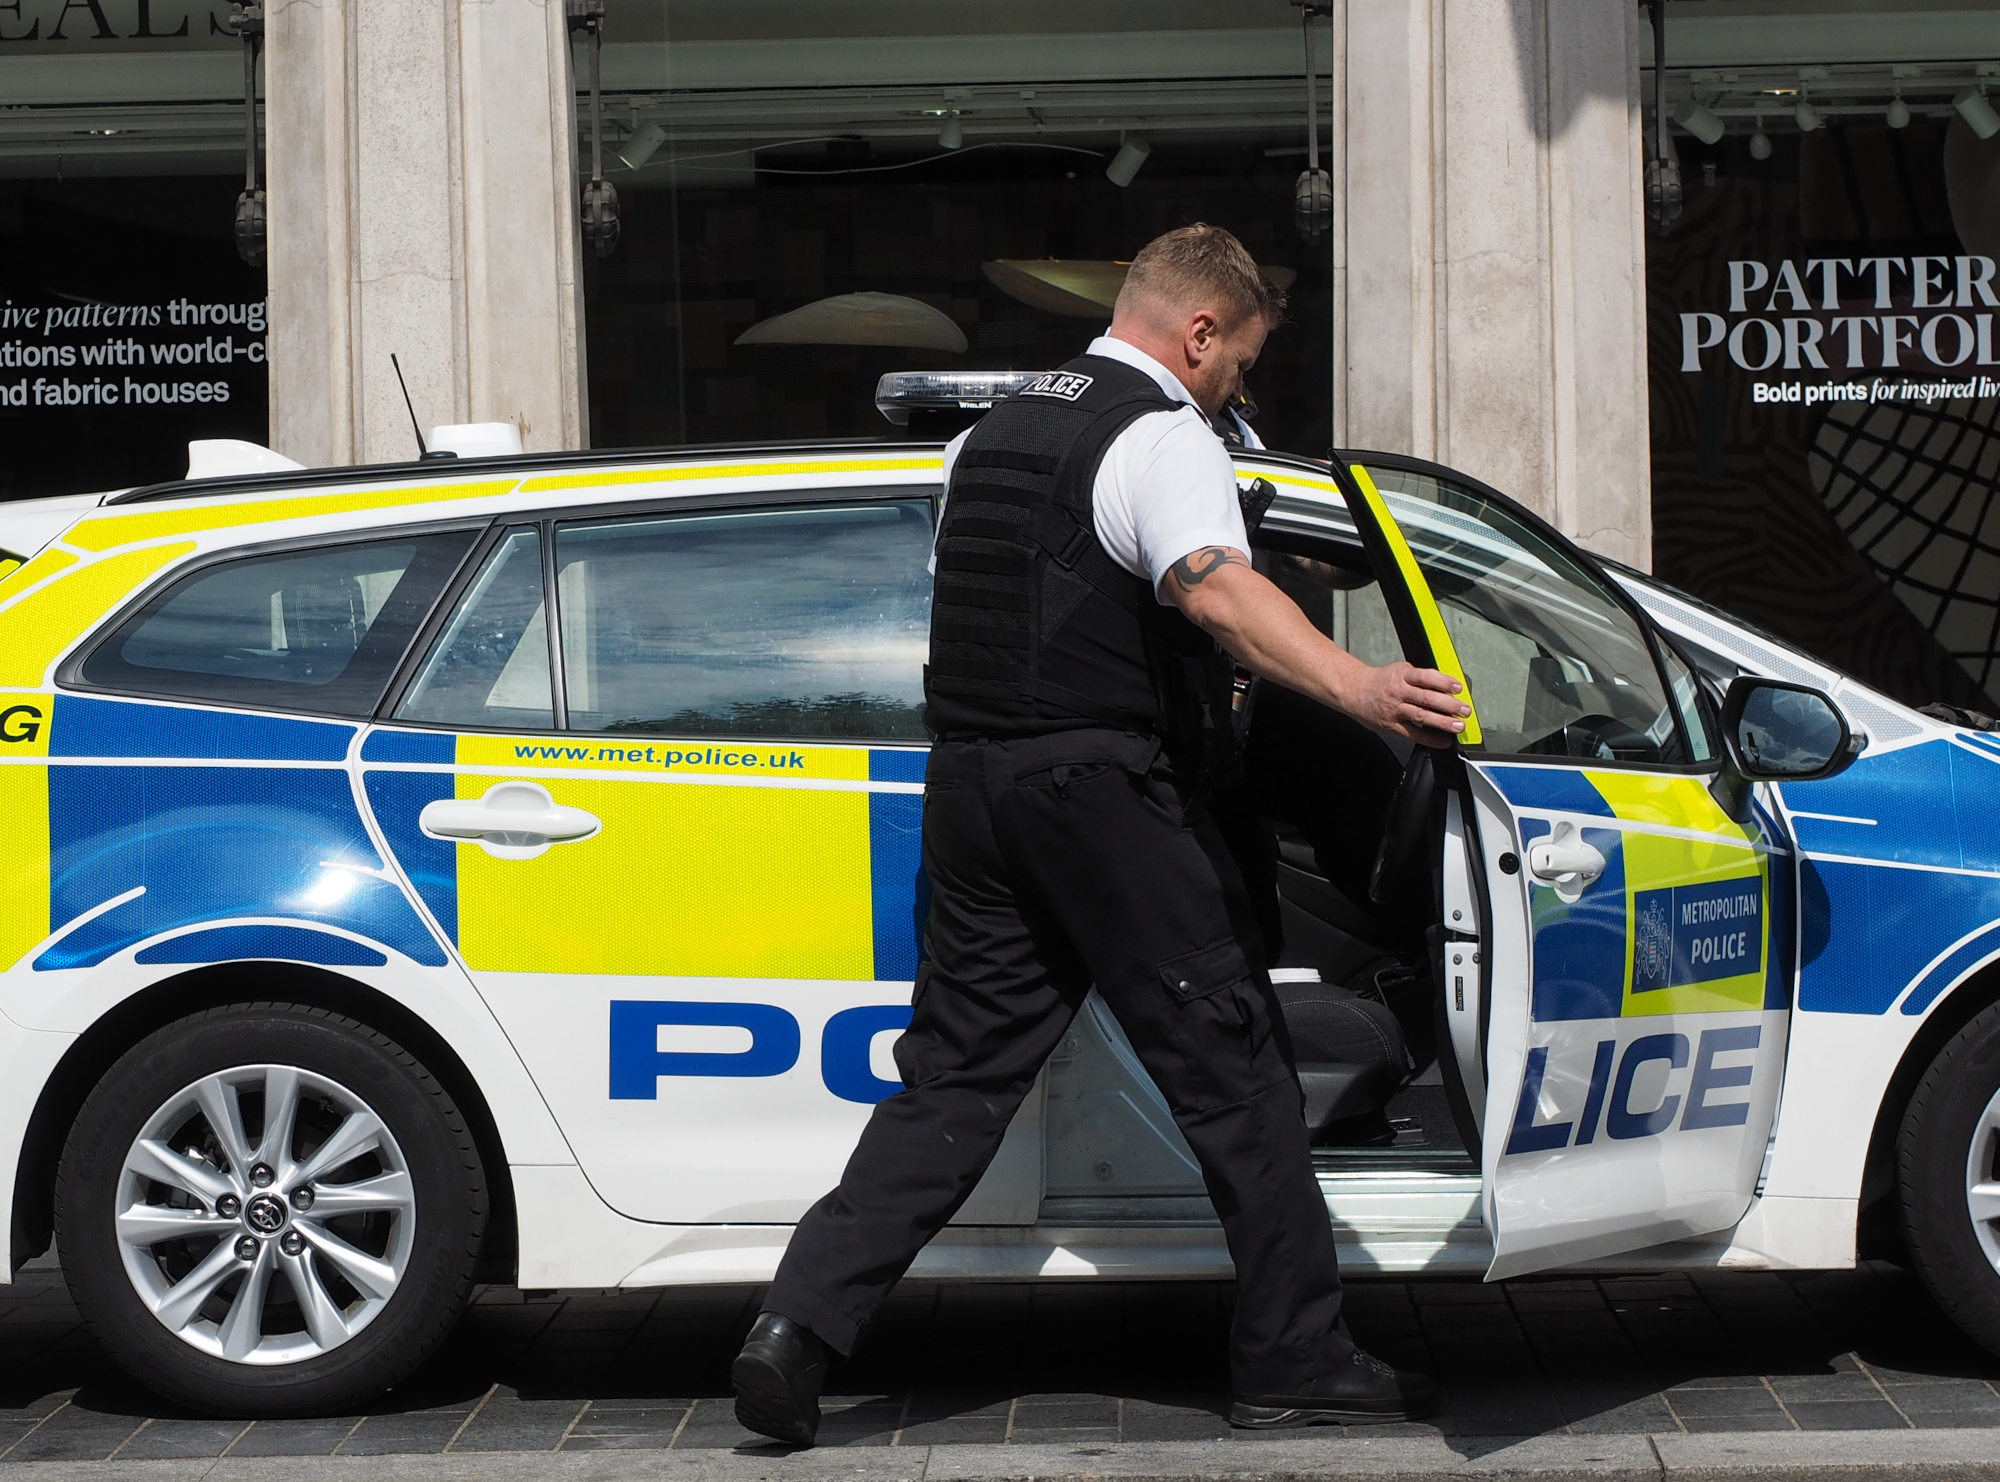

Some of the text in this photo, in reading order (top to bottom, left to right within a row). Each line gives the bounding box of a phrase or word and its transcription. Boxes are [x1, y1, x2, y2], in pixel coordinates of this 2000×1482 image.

[1727, 255, 2000, 312] PATTER
[0, 299, 40, 329] ive
[43, 303, 162, 336] patterns
[0, 339, 77, 367] tions
[80, 338, 145, 366] with
[32, 377, 119, 406] fabric
[124, 376, 230, 405] houses
[1025, 374, 1085, 396] POLICE
[1753, 382, 1801, 403] Bold
[1805, 380, 1868, 406] prints
[1869, 377, 1899, 404] for
[1901, 376, 1977, 405] inspired
[514, 745, 805, 769] www.met.police.uk
[1681, 893, 1757, 926] METROPOLITAN
[1691, 932, 1747, 965] POLICE
[1504, 1025, 1762, 1156] LICE
